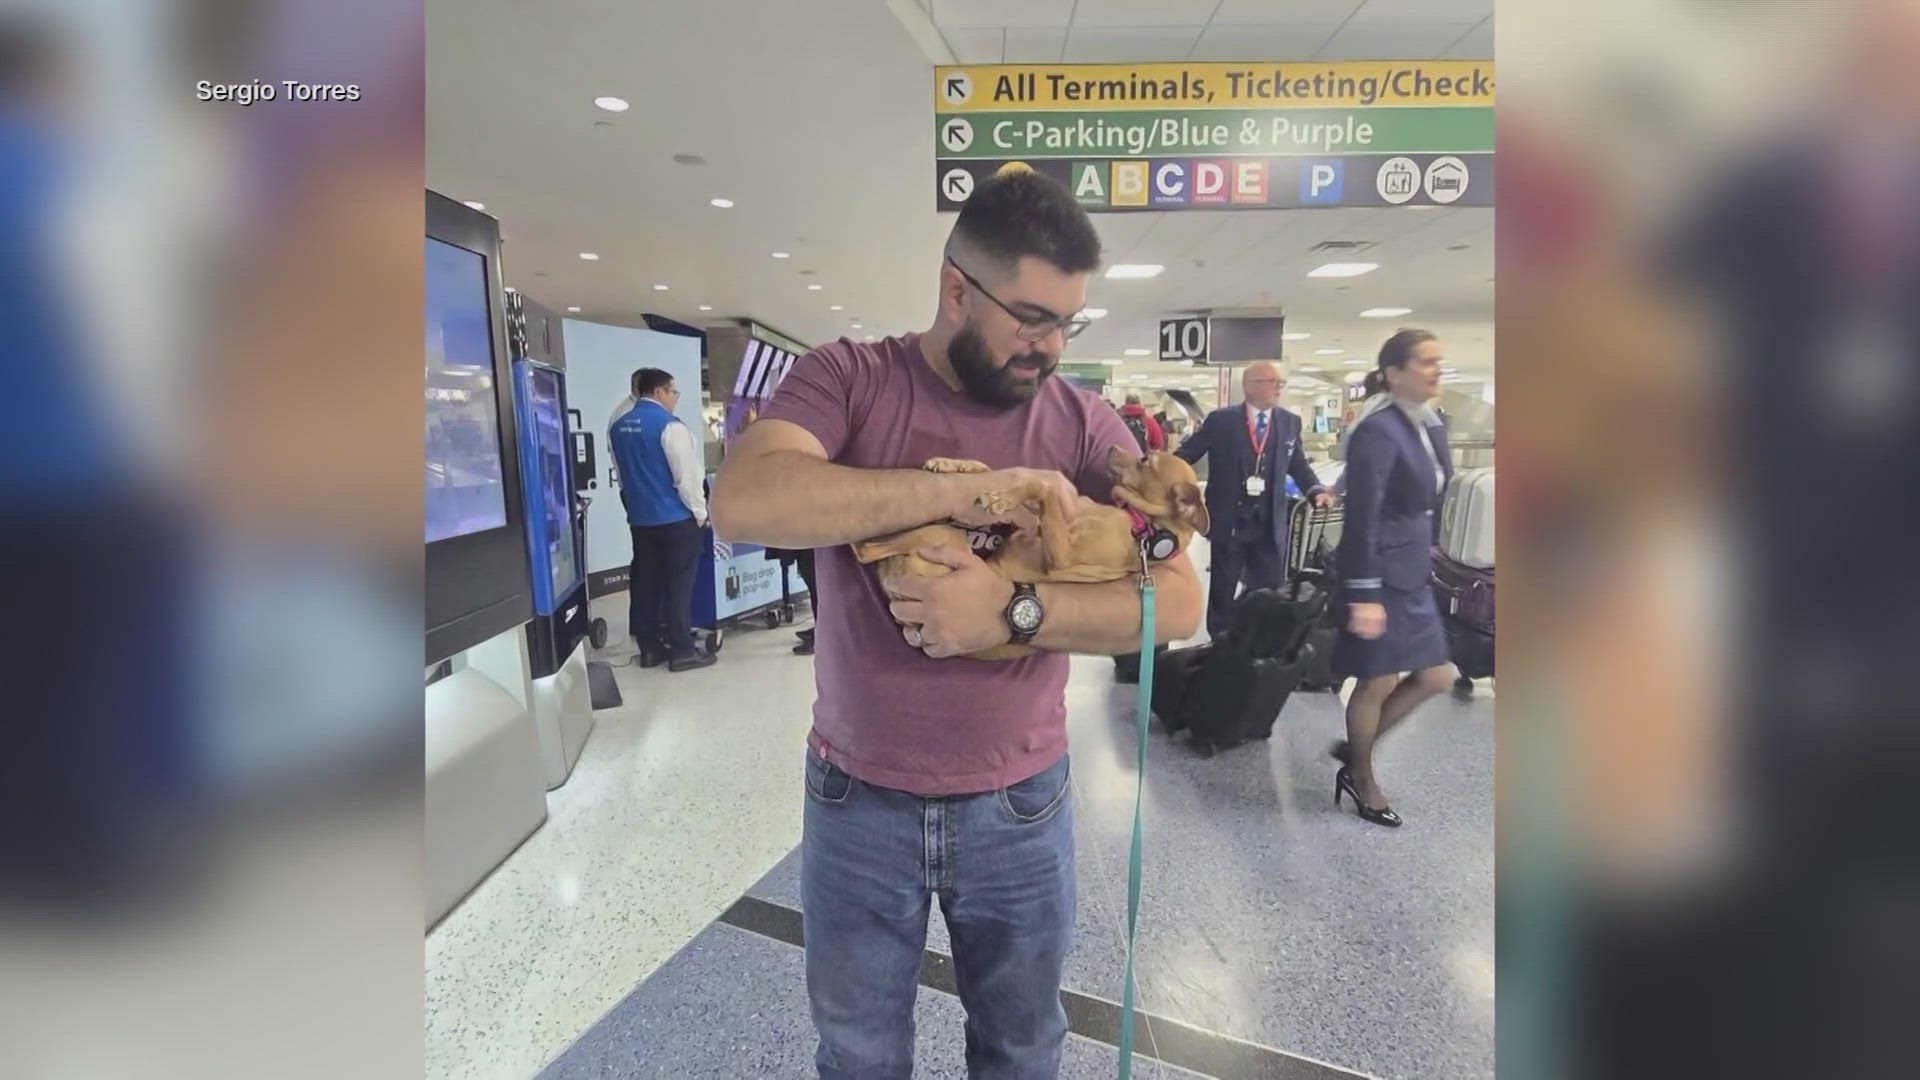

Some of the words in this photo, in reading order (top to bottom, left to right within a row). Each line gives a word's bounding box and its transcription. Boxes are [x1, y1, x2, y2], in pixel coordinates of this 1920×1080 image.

[993, 73, 1035, 101] All
[1046, 71, 1215, 103] Terminals,
[993, 117, 1229, 154] C-Parking/Blue
[1239, 117, 1260, 145] &
[1272, 115, 1374, 150] Purple
[1075, 165, 1104, 196] A
[1119, 164, 1143, 193] B
[1156, 163, 1185, 196] C
[1197, 163, 1224, 194] D
[1237, 163, 1262, 194] E
[1311, 164, 1335, 197] P
[1161, 321, 1206, 359] 10
